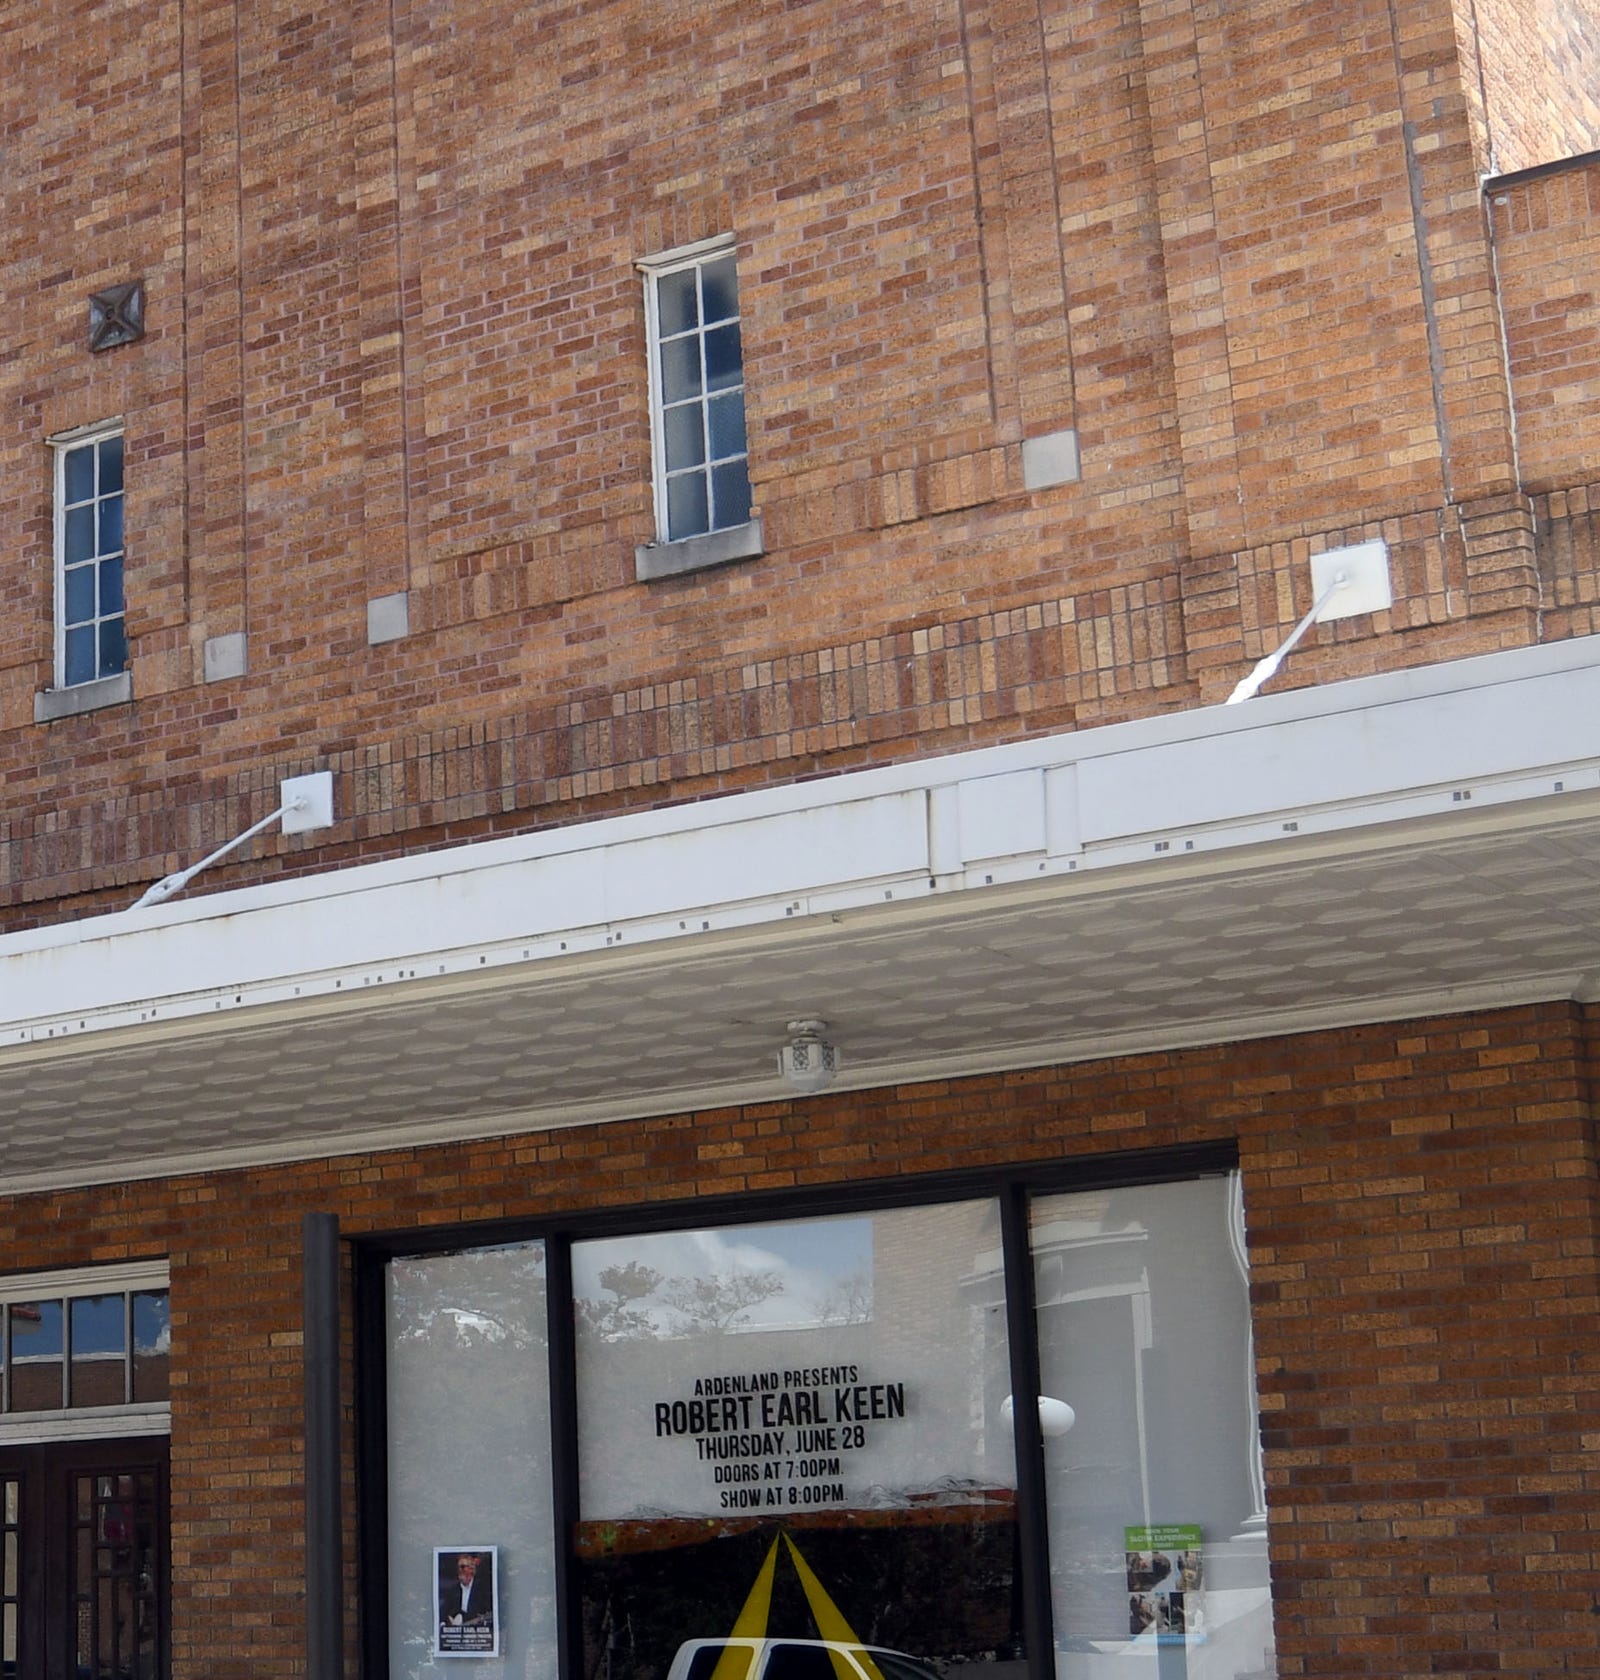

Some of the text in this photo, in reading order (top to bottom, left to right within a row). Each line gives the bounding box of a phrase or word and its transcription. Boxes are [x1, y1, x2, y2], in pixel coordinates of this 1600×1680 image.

[694, 1365, 858, 1396] ARDENLAND PRESENTS
[655, 1383, 905, 1436] ROBERT EARL KEEN
[696, 1425, 866, 1460] THURSDAY, JUNE 28
[714, 1464, 759, 1483] DOORS
[764, 1461, 781, 1479] AT
[720, 1489, 762, 1508] SHOW
[766, 1487, 783, 1505] AT
